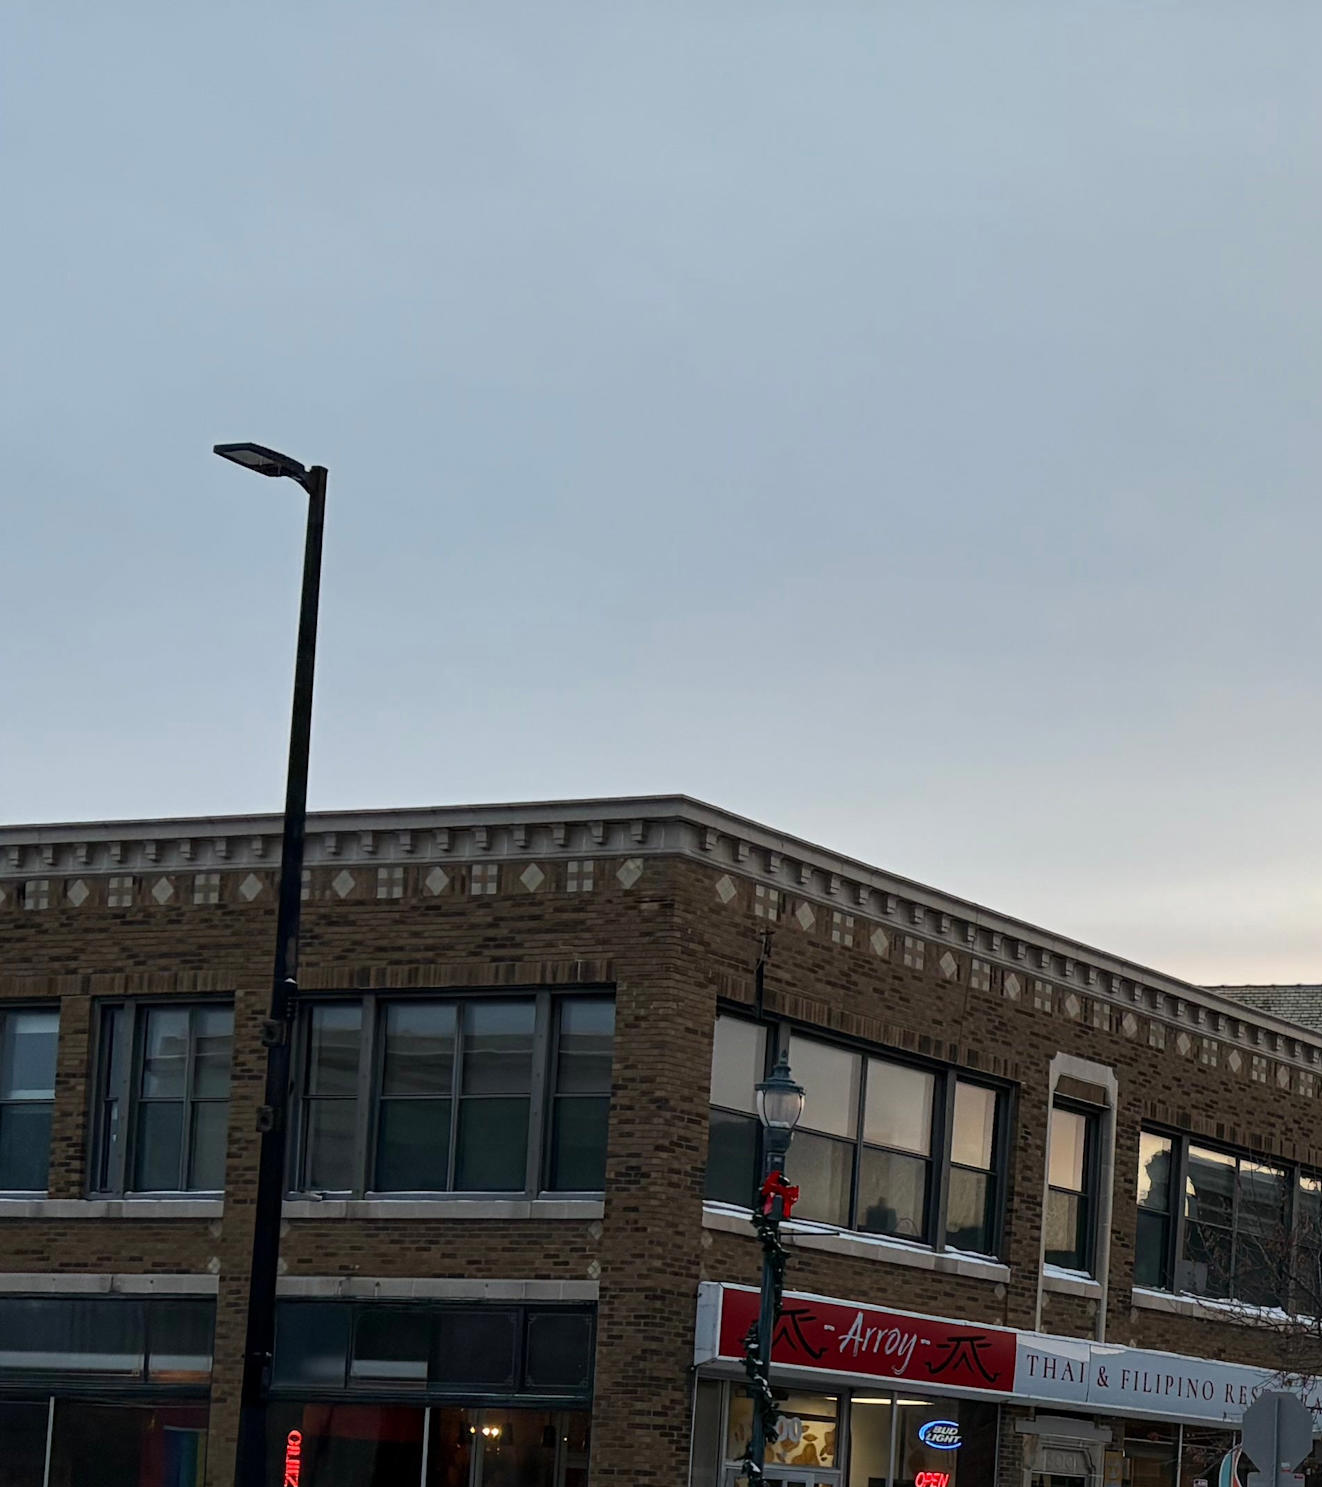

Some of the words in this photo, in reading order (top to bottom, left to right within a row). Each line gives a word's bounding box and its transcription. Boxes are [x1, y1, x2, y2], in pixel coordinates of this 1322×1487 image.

[1027, 1354, 1086, 1384] THAI
[1096, 1366, 1110, 1388] &
[1121, 1368, 1215, 1402] FILIPINO
[934, 1425, 959, 1436] BUD
[926, 1433, 962, 1444] LIGHT
